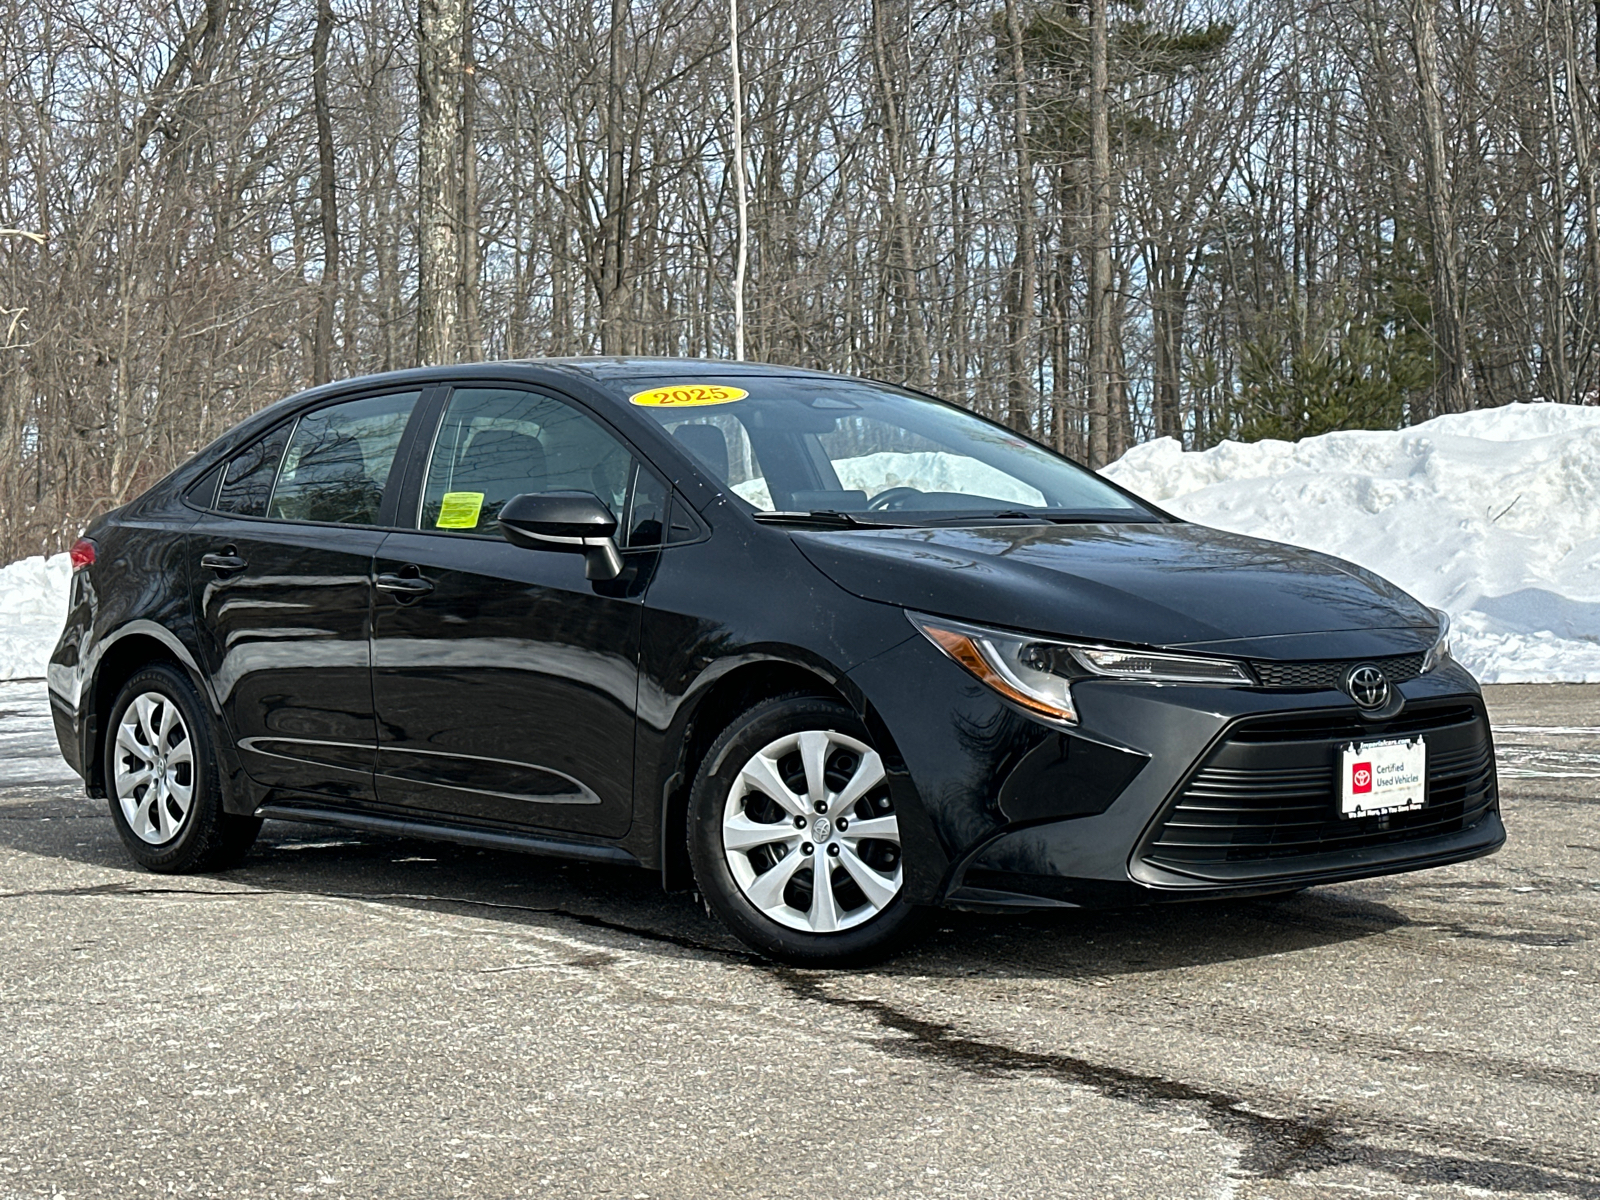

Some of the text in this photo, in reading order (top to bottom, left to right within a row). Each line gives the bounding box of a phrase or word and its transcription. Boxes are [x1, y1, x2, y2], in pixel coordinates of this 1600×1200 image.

[653, 388, 729, 404] 2025
[1377, 762, 1404, 774] Certified
[1377, 774, 1419, 787] Used Vehicles
